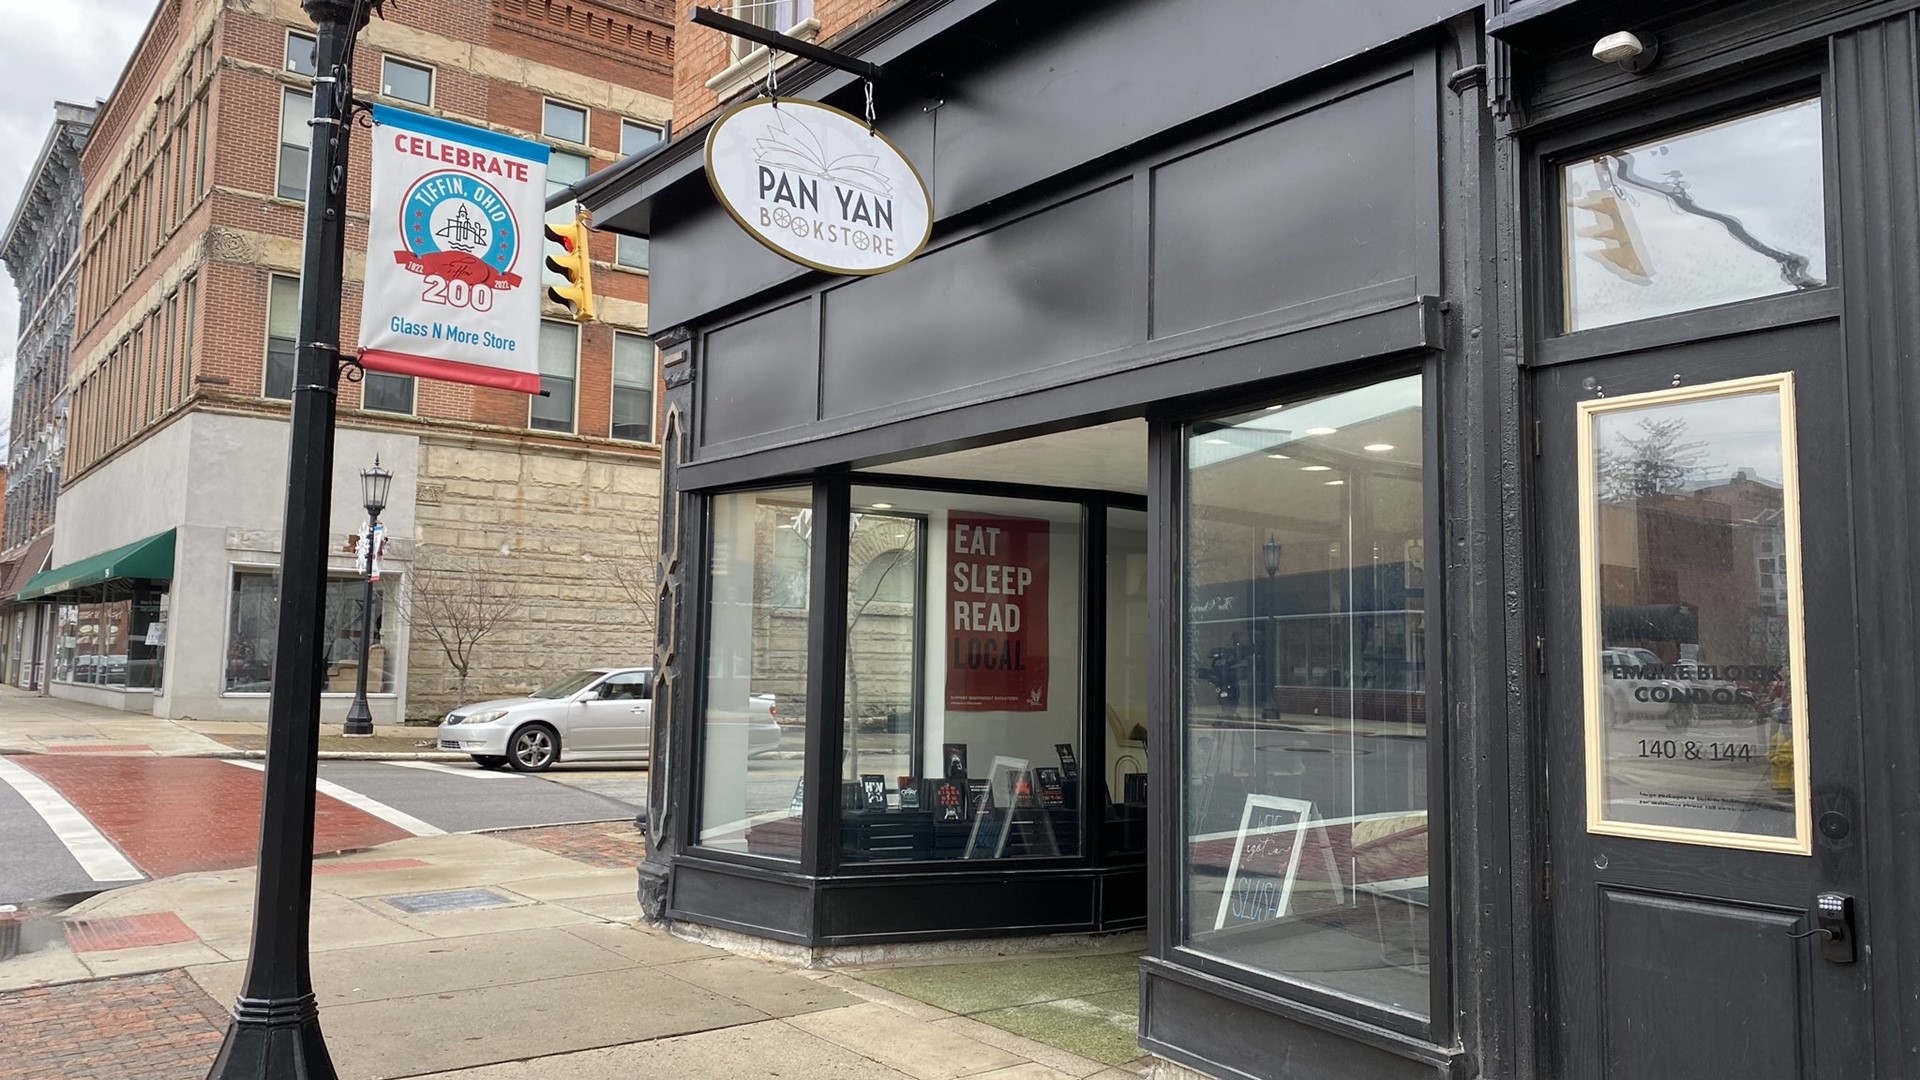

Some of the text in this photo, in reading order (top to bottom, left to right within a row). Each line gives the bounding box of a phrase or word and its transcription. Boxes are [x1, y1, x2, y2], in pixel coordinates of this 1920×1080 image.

[394, 133, 529, 183] CELEBRATE
[415, 178, 507, 222] TIFFIN, OHIO
[758, 165, 893, 232] PAN YAN
[759, 206, 894, 257] BOOKSTORE
[407, 261, 424, 273] 1822
[494, 280, 510, 289] 2022
[421, 273, 494, 312] 200
[390, 315, 516, 352] Glass N More Store
[954, 523, 1000, 557] EAT
[953, 561, 1033, 596] SLEEP
[953, 600, 1021, 633] READ
[953, 637, 1026, 672] LOCAL
[1634, 686, 1757, 705] CONDOS
[1638, 739, 1751, 763] 140 & 144
